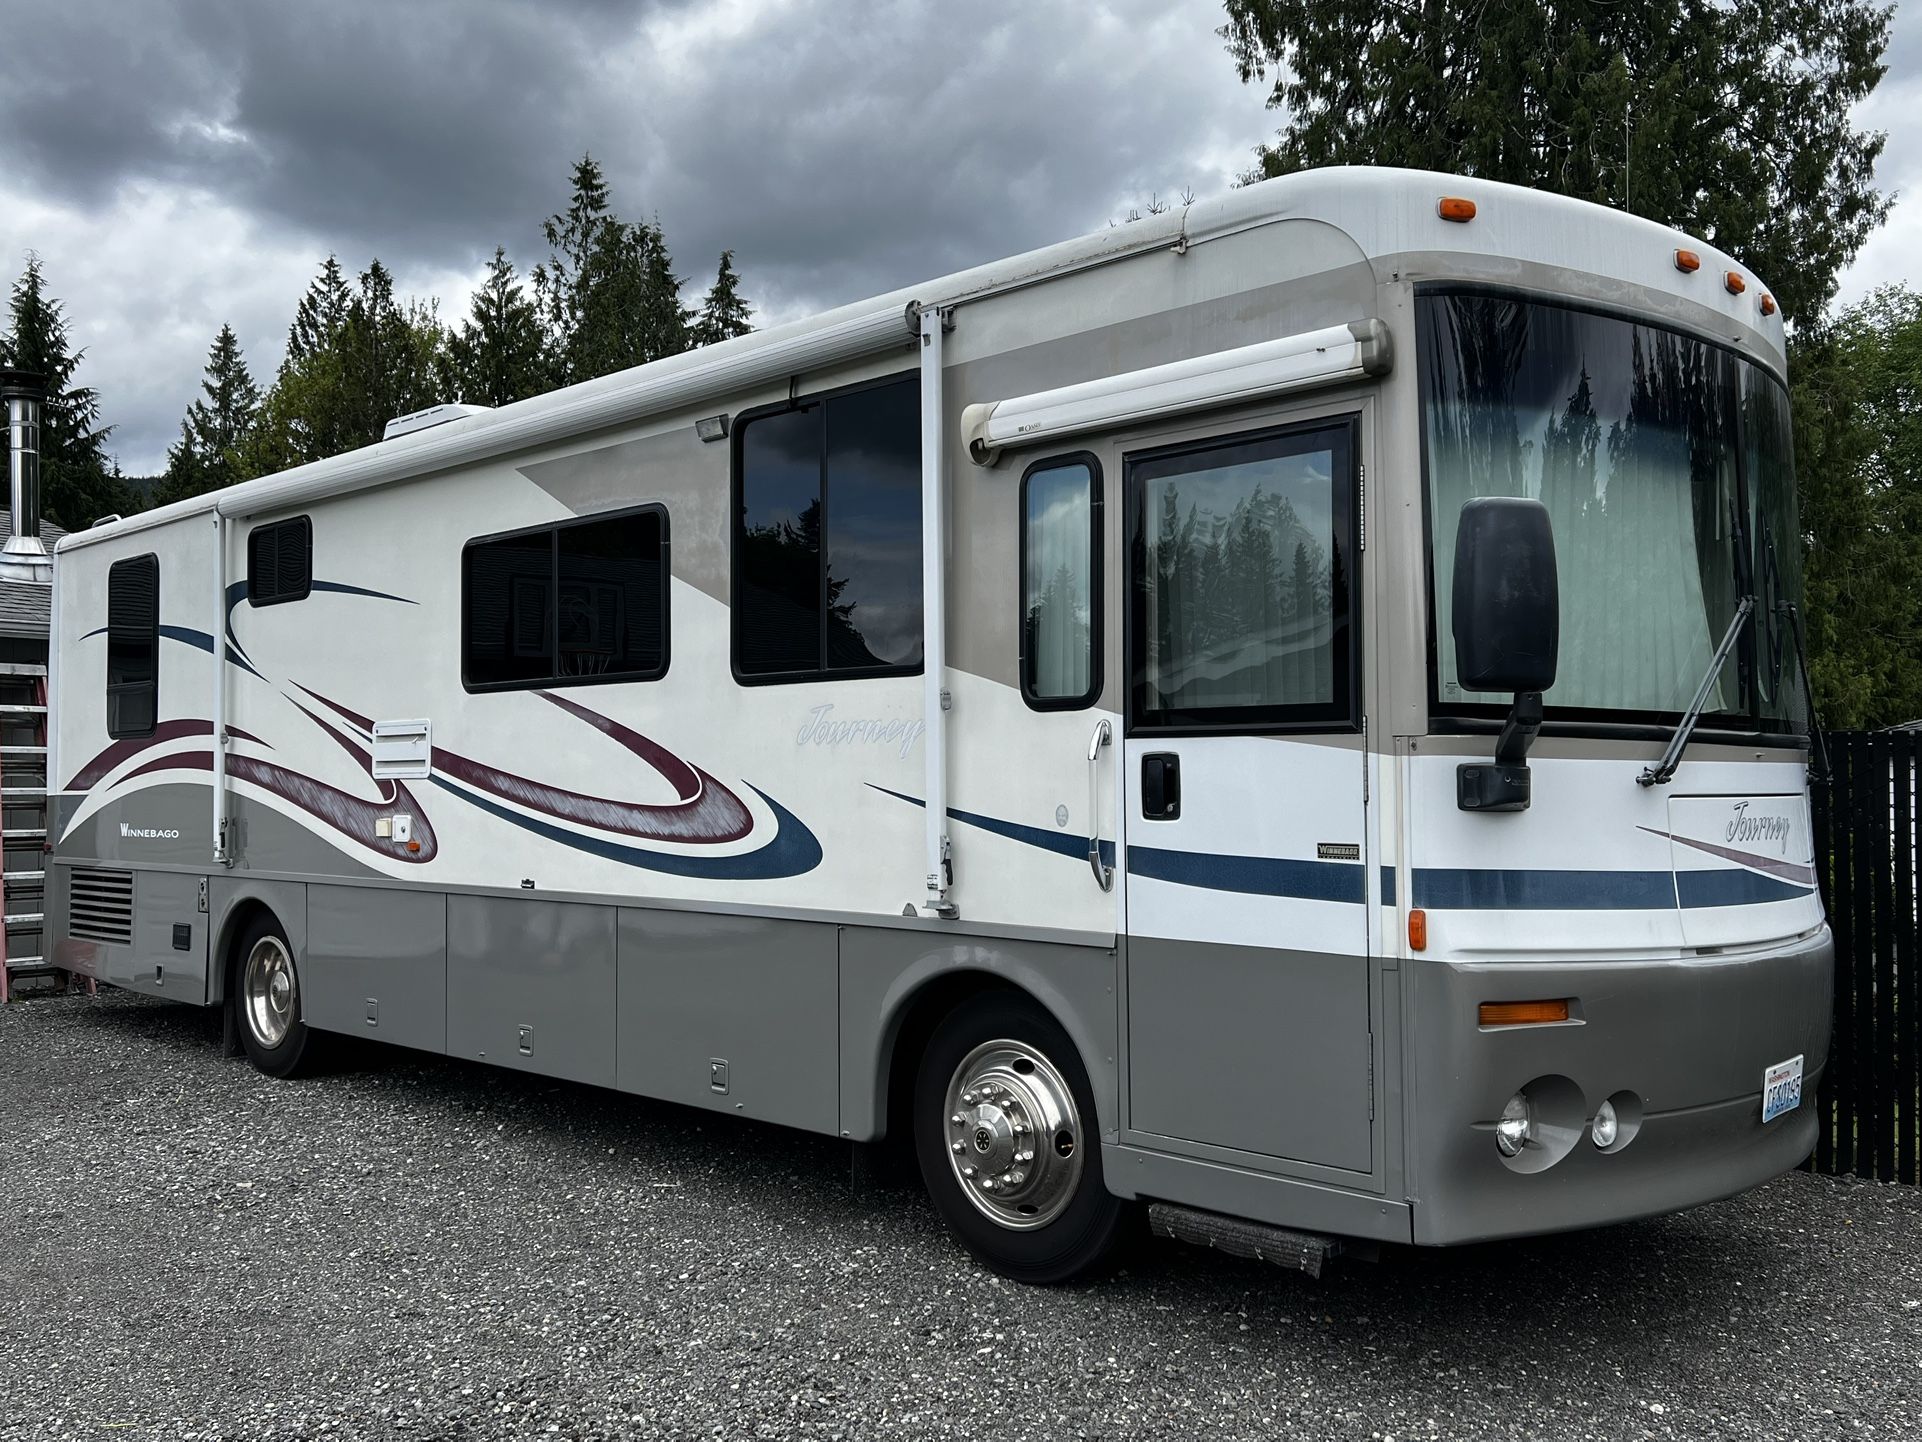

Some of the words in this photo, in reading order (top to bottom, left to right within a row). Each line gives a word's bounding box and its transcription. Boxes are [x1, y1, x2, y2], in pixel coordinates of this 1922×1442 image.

[797, 704, 926, 759] Journey
[120, 822, 179, 838] WINNEBAGO
[1726, 800, 1790, 855] Journey
